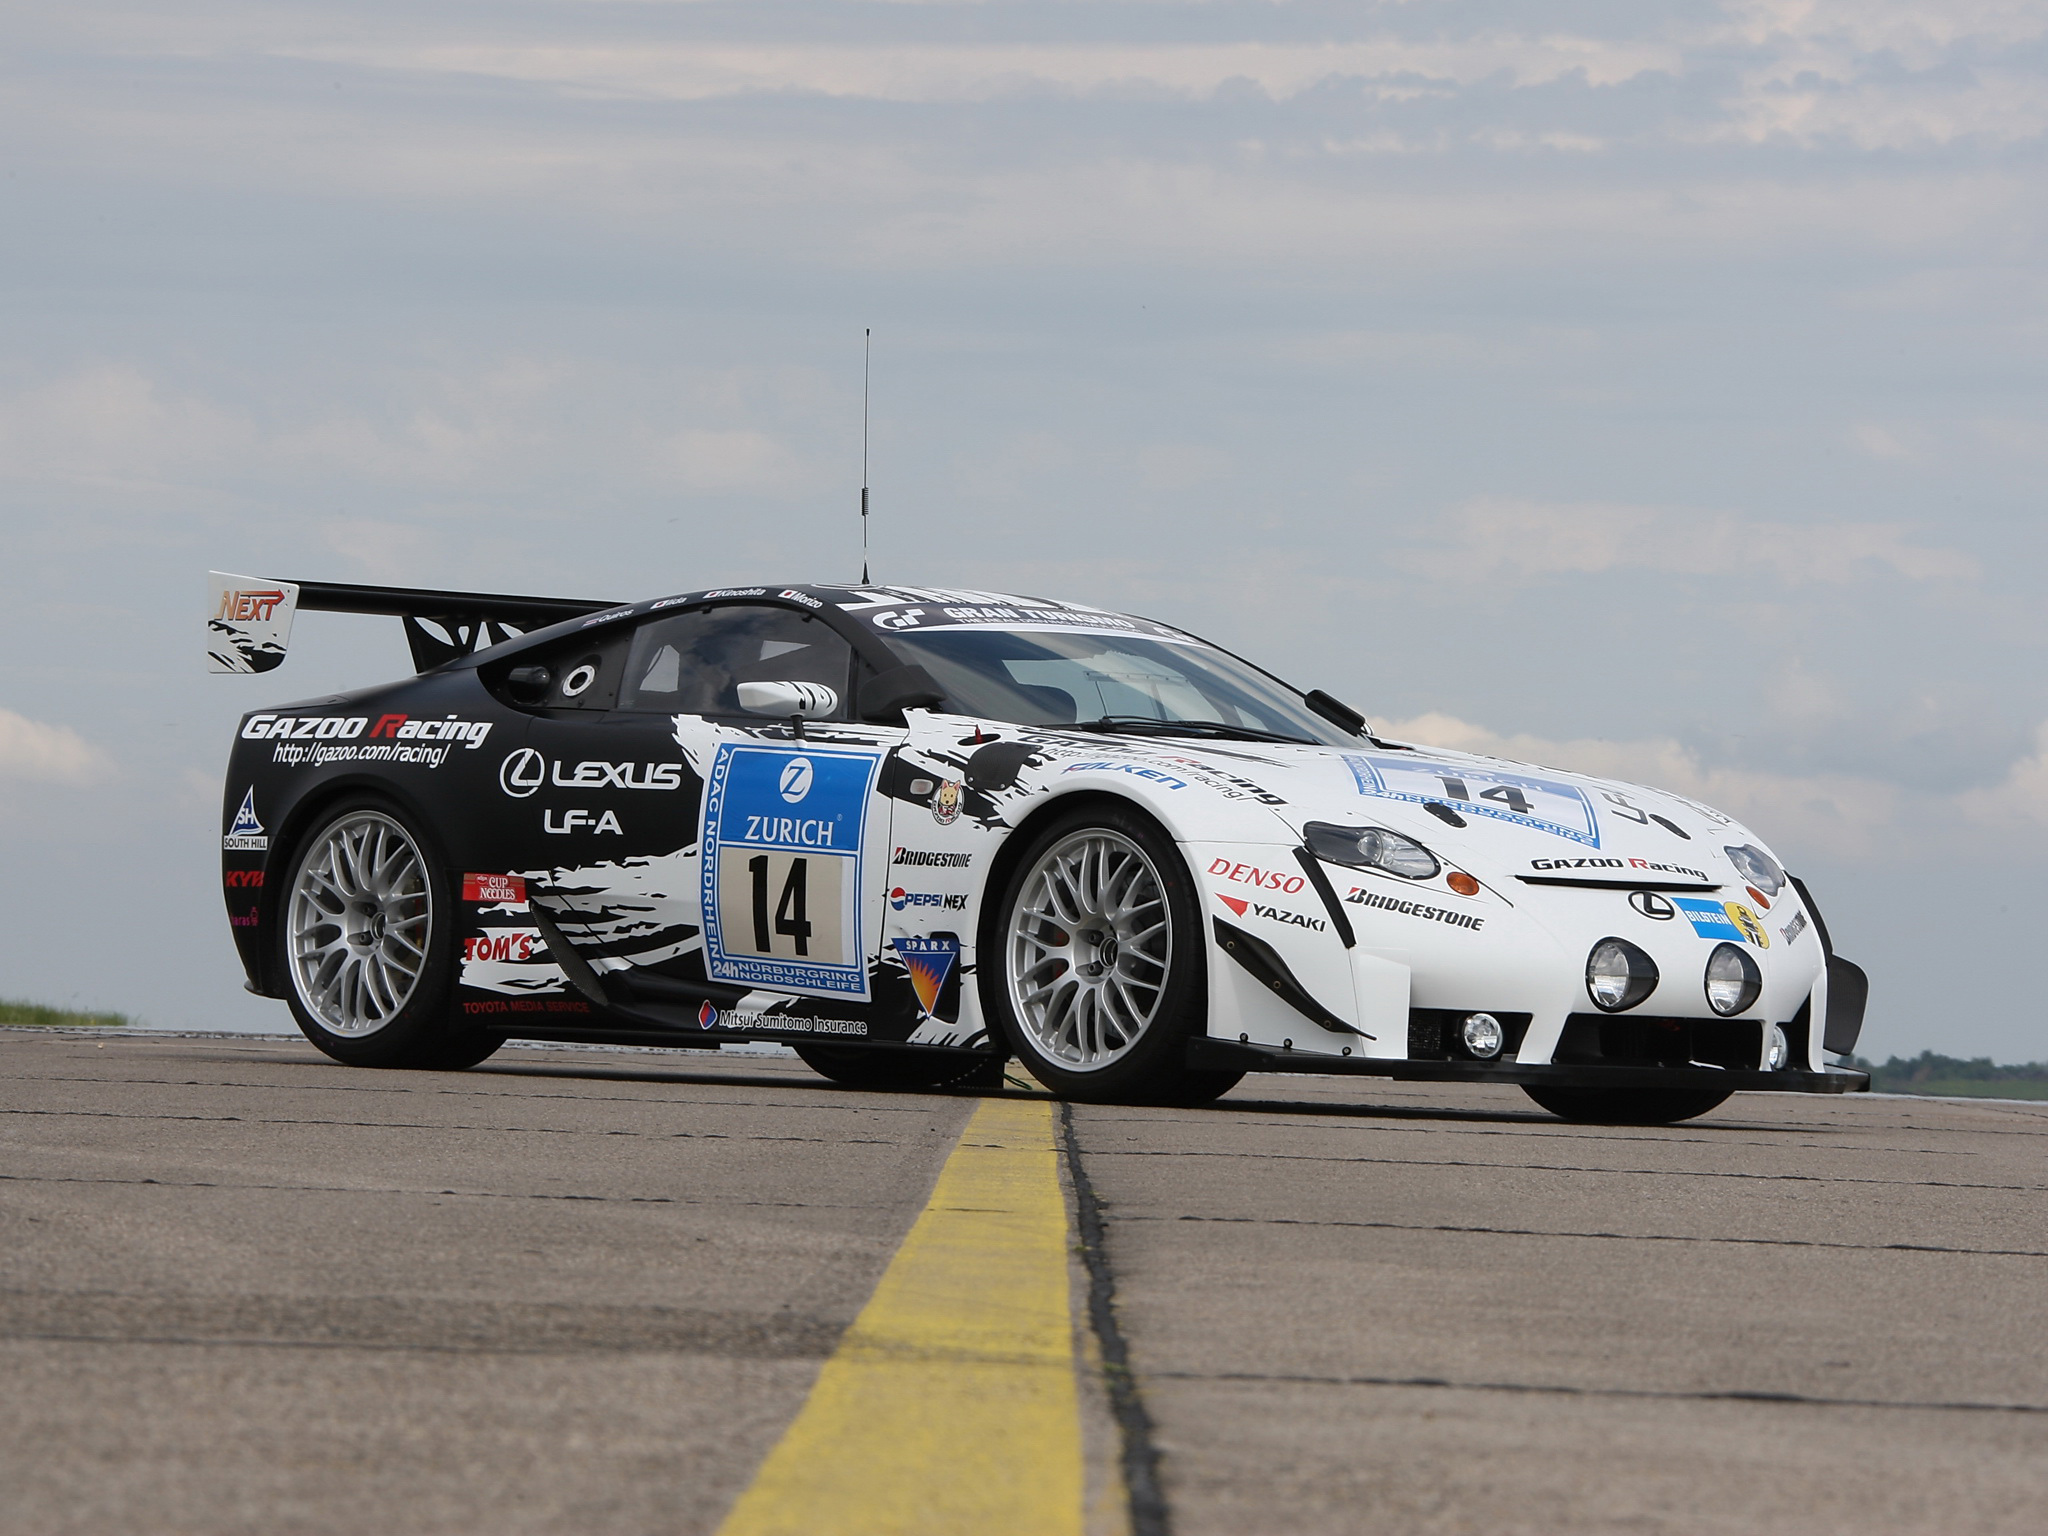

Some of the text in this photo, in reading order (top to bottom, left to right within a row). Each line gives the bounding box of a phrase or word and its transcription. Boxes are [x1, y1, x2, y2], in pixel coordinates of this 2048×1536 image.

[718, 588, 766, 597] Kinoshita
[793, 592, 823, 608] Morizo
[214, 590, 285, 621] NEXT
[943, 607, 1136, 628] GRAN TURISMO
[241, 713, 493, 749] GAZOO Racing
[272, 742, 451, 768] http://gazoo.com/racing/
[552, 760, 683, 790] LEXUS
[1060, 762, 1188, 791] FALKEN
[1157, 755, 1289, 806] Racing
[1434, 775, 1535, 814] 14
[238, 807, 256, 825] SH
[544, 809, 623, 835] LF-A
[224, 837, 267, 849] SOUTH HILL
[744, 815, 833, 846] ZURICH
[703, 748, 729, 958] ADAC NORDRHEIN
[892, 847, 972, 868] BRIDGESTONE
[489, 877, 508, 888] CUP
[1207, 858, 1305, 894] DENSO
[1531, 858, 1710, 882] GAZOO Racing
[480, 888, 516, 900] NOODLES
[748, 854, 812, 956] 14
[905, 893, 969, 911] PEPSI NEX
[1253, 903, 1326, 932] YAZAKI
[1343, 887, 1485, 931] BRIDGESTONE
[1685, 910, 1732, 926] BILSTEIN
[464, 933, 533, 961] TOM'S
[906, 941, 950, 951] SPARX
[713, 960, 860, 982] 24h NÜRBURGRING
[739, 972, 861, 991] NORDSCHLEIFE
[464, 1002, 590, 1014] TOYOTA MEDIA SERVICE
[719, 1010, 868, 1035] Mitsui Sumitomo Insurance
